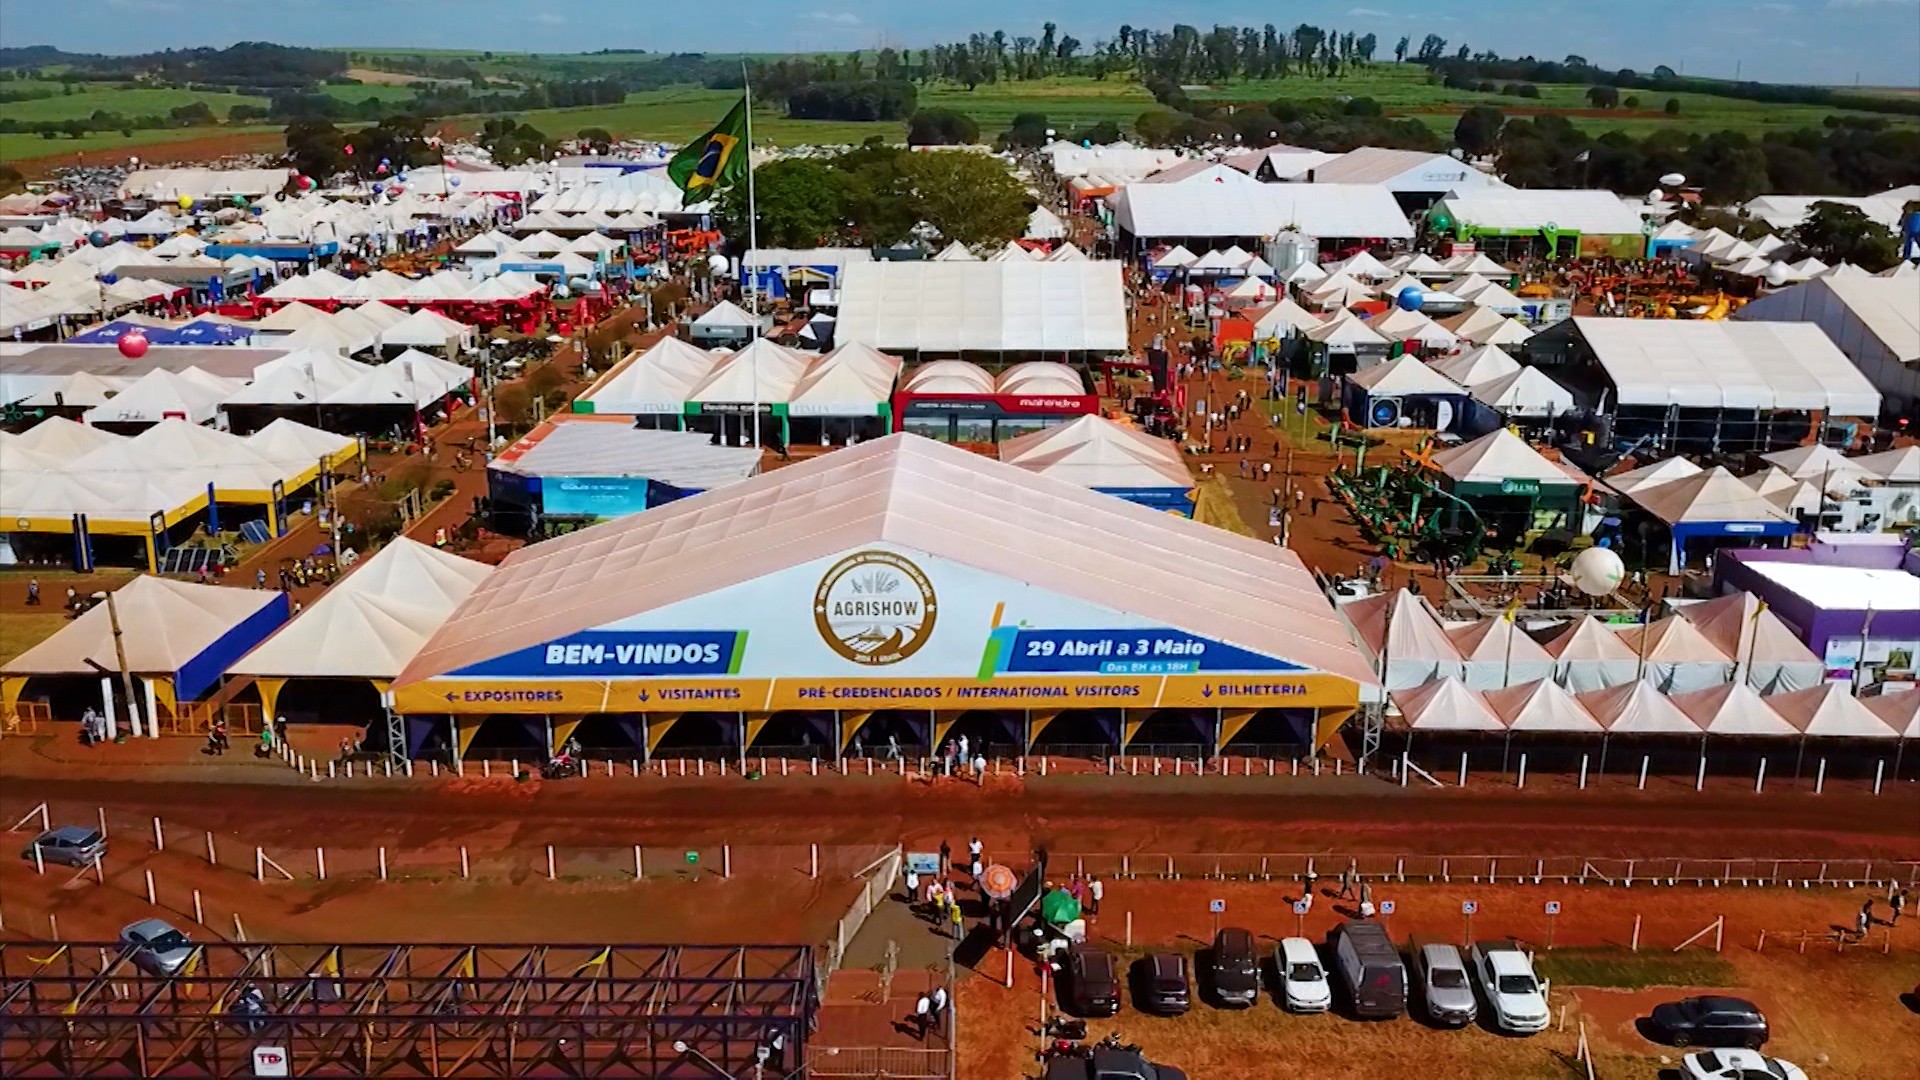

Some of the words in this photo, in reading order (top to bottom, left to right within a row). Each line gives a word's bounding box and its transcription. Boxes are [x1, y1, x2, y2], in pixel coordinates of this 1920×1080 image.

[834, 601, 918, 616] AGRISHOW
[545, 643, 720, 665] BEM-VINDOS
[1026, 640, 1056, 656] 29
[1059, 639, 1113, 656] Abril
[1116, 643, 1130, 656] a
[1134, 639, 1150, 656] 3
[1153, 639, 1206, 655] Maio
[464, 690, 563, 702] EXPOSITORES
[658, 688, 741, 700] VISITANTES
[798, 686, 942, 699] PRÉ-CREDENCIADOS
[957, 687, 1069, 698] INTERNATIONAL
[1075, 685, 1140, 697] VISITORS
[1218, 685, 1308, 696] BILHETERIA
